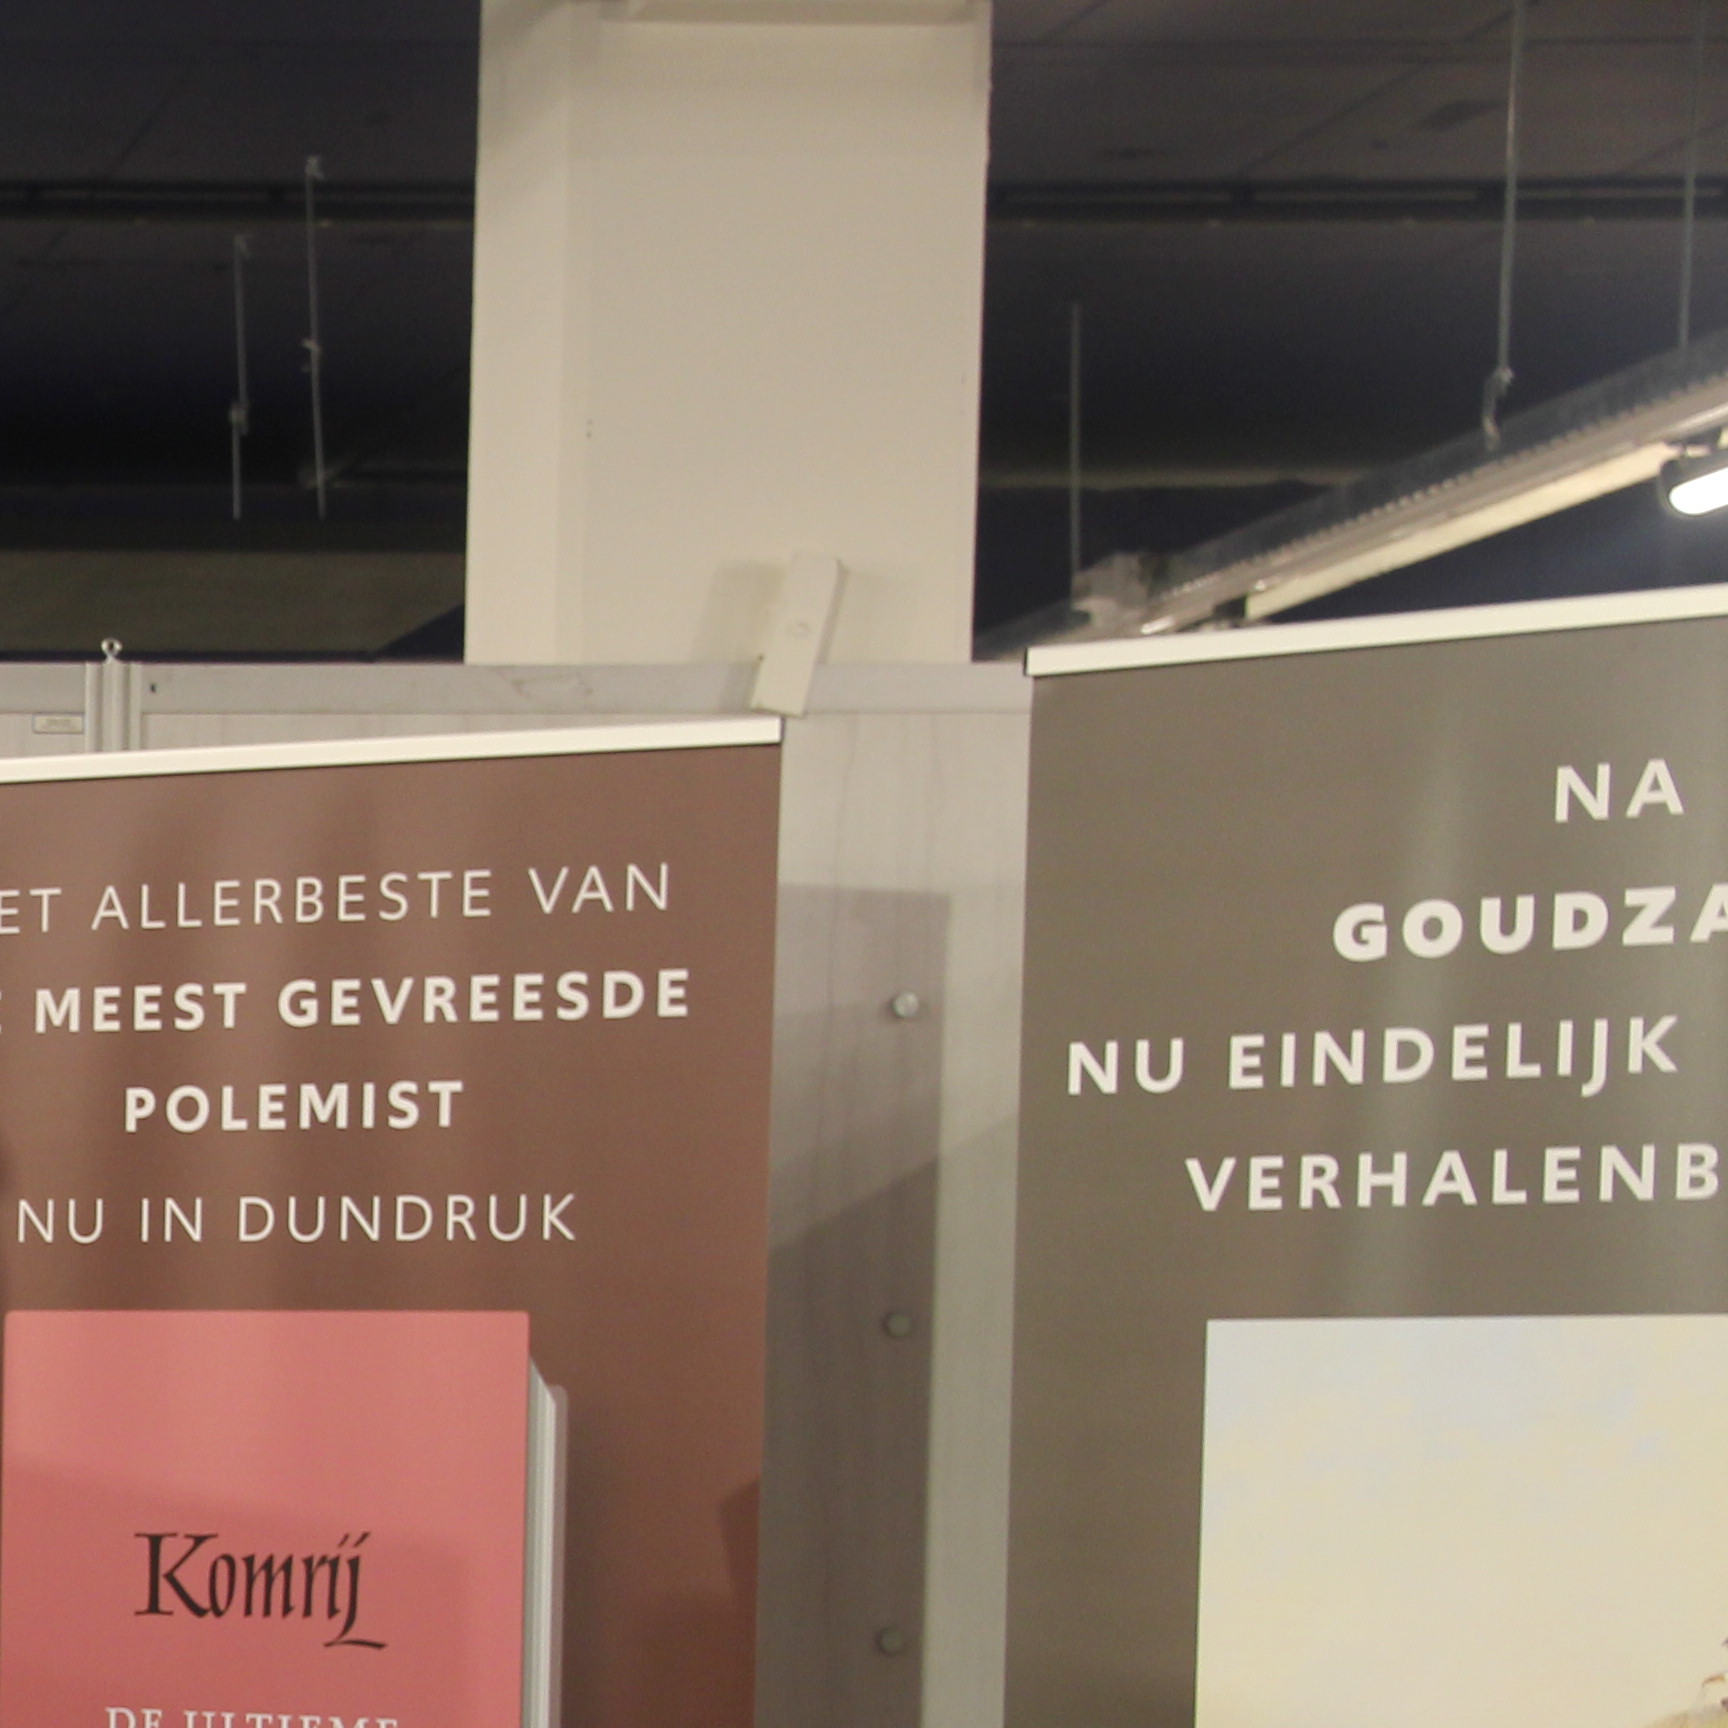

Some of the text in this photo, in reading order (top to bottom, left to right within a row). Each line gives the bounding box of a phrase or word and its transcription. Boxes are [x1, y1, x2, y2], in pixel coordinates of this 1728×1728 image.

[1555, 758, 1684, 823] NA
[92, 869, 492, 932] ALLERBESTE
[528, 862, 669, 915] VAN
[35, 983, 247, 1033] MEEST
[278, 968, 690, 1028] GEVREESDE
[1068, 1015, 1678, 1097] NU EINDELIJK
[124, 1080, 464, 1132] POLEMIST
[1185, 1143, 1720, 1212] VERHALENB
[17, 1192, 576, 1244] NU IN DUNDRUK
[134, 1530, 387, 1650] Komrij
